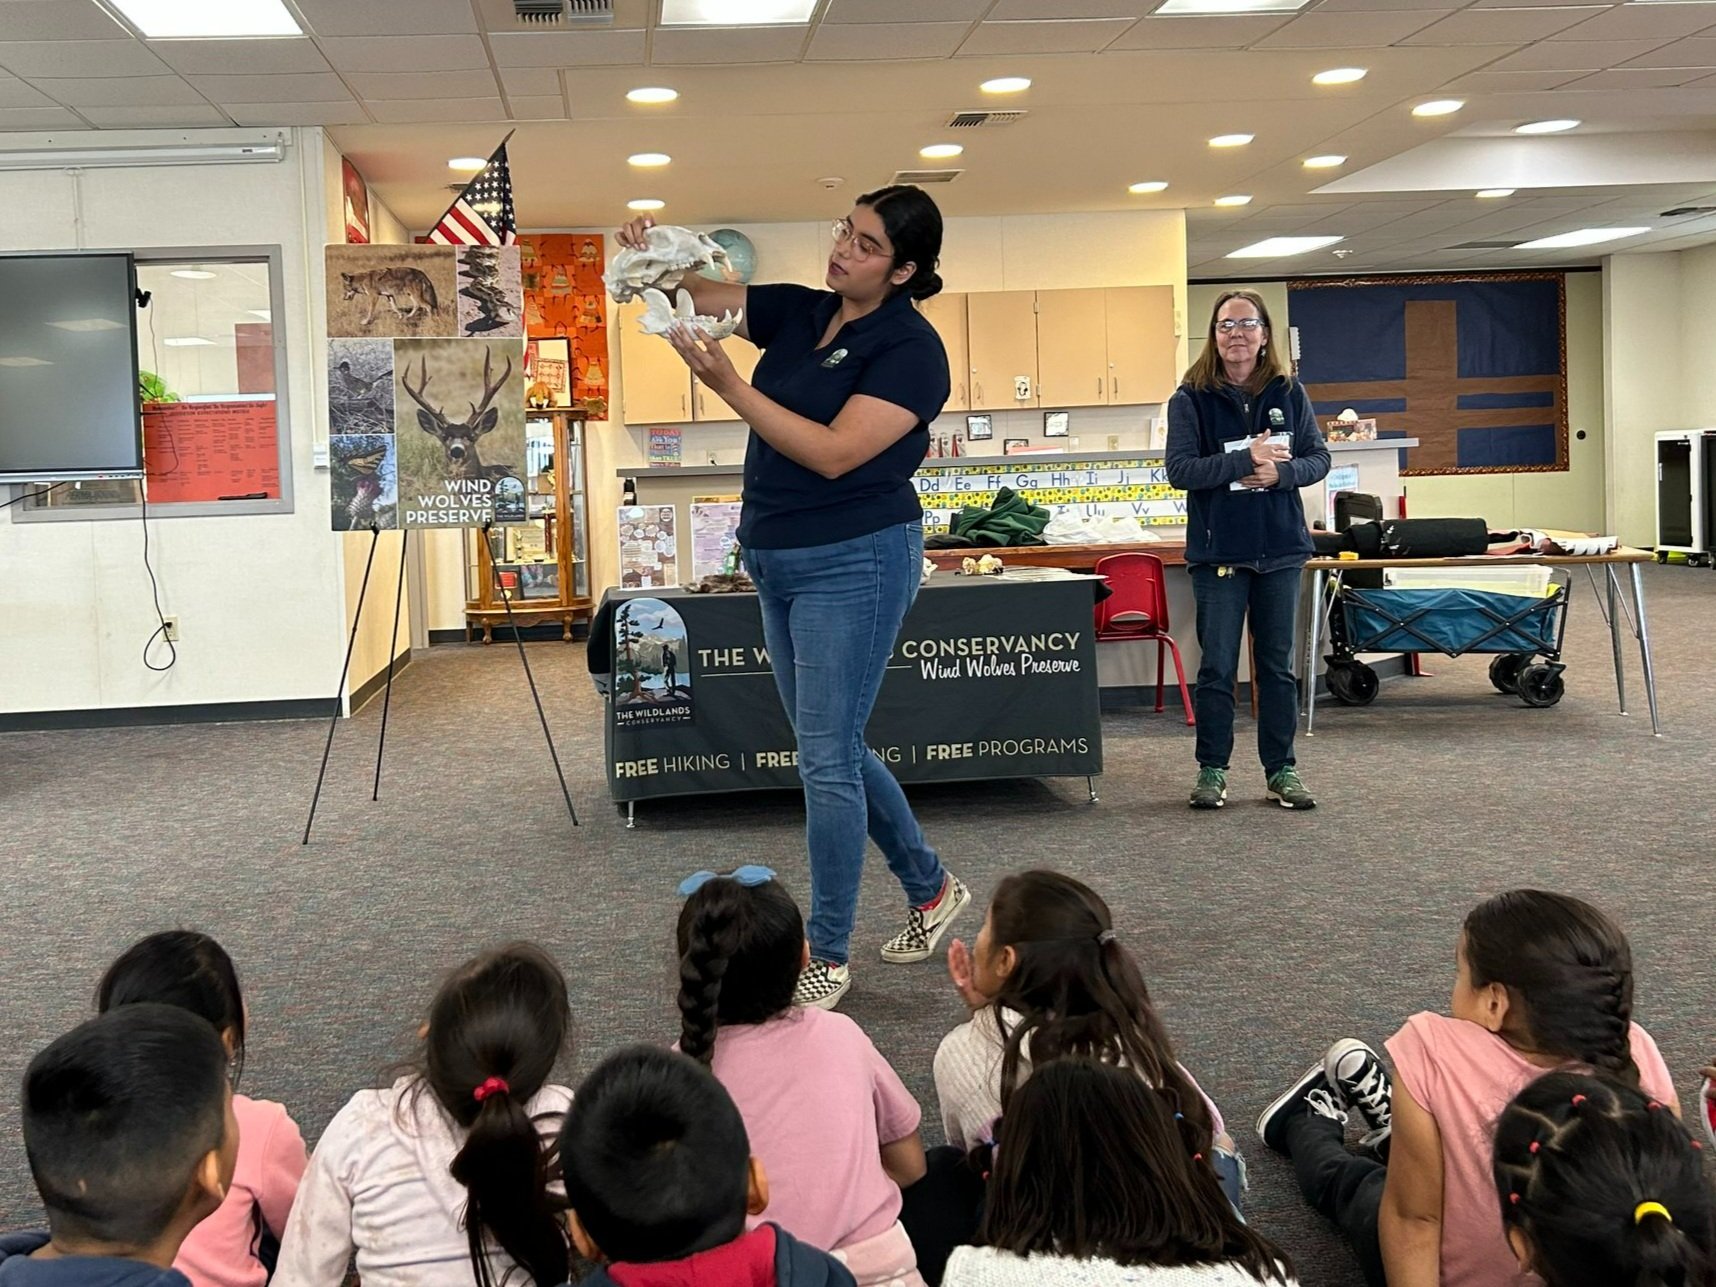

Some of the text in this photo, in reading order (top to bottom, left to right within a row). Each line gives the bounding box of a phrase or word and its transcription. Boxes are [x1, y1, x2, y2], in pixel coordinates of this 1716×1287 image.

[444, 479, 492, 493] WIND
[920, 478, 940, 491] Dd
[955, 476, 971, 490] Ee
[987, 475, 1001, 489] Ff
[1051, 472, 1070, 486] Hh
[1086, 471, 1098, 485] Ii
[1117, 470, 1130, 486] Jj
[418, 494, 492, 508] WOLVES
[406, 508, 492, 524] PRESERVE
[924, 510, 941, 527] Pp
[1131, 502, 1150, 515] Vv
[902, 632, 1081, 659] CONSERVANCY
[697, 647, 745, 667] THE
[920, 653, 1081, 680] Wind Wolves Preserve
[616, 706, 691, 720] THE WILDLANDS
[615, 757, 659, 779] FREE
[663, 753, 730, 773] HIKING
[926, 743, 974, 761] FREE
[979, 737, 1089, 757] PROGRAMS
